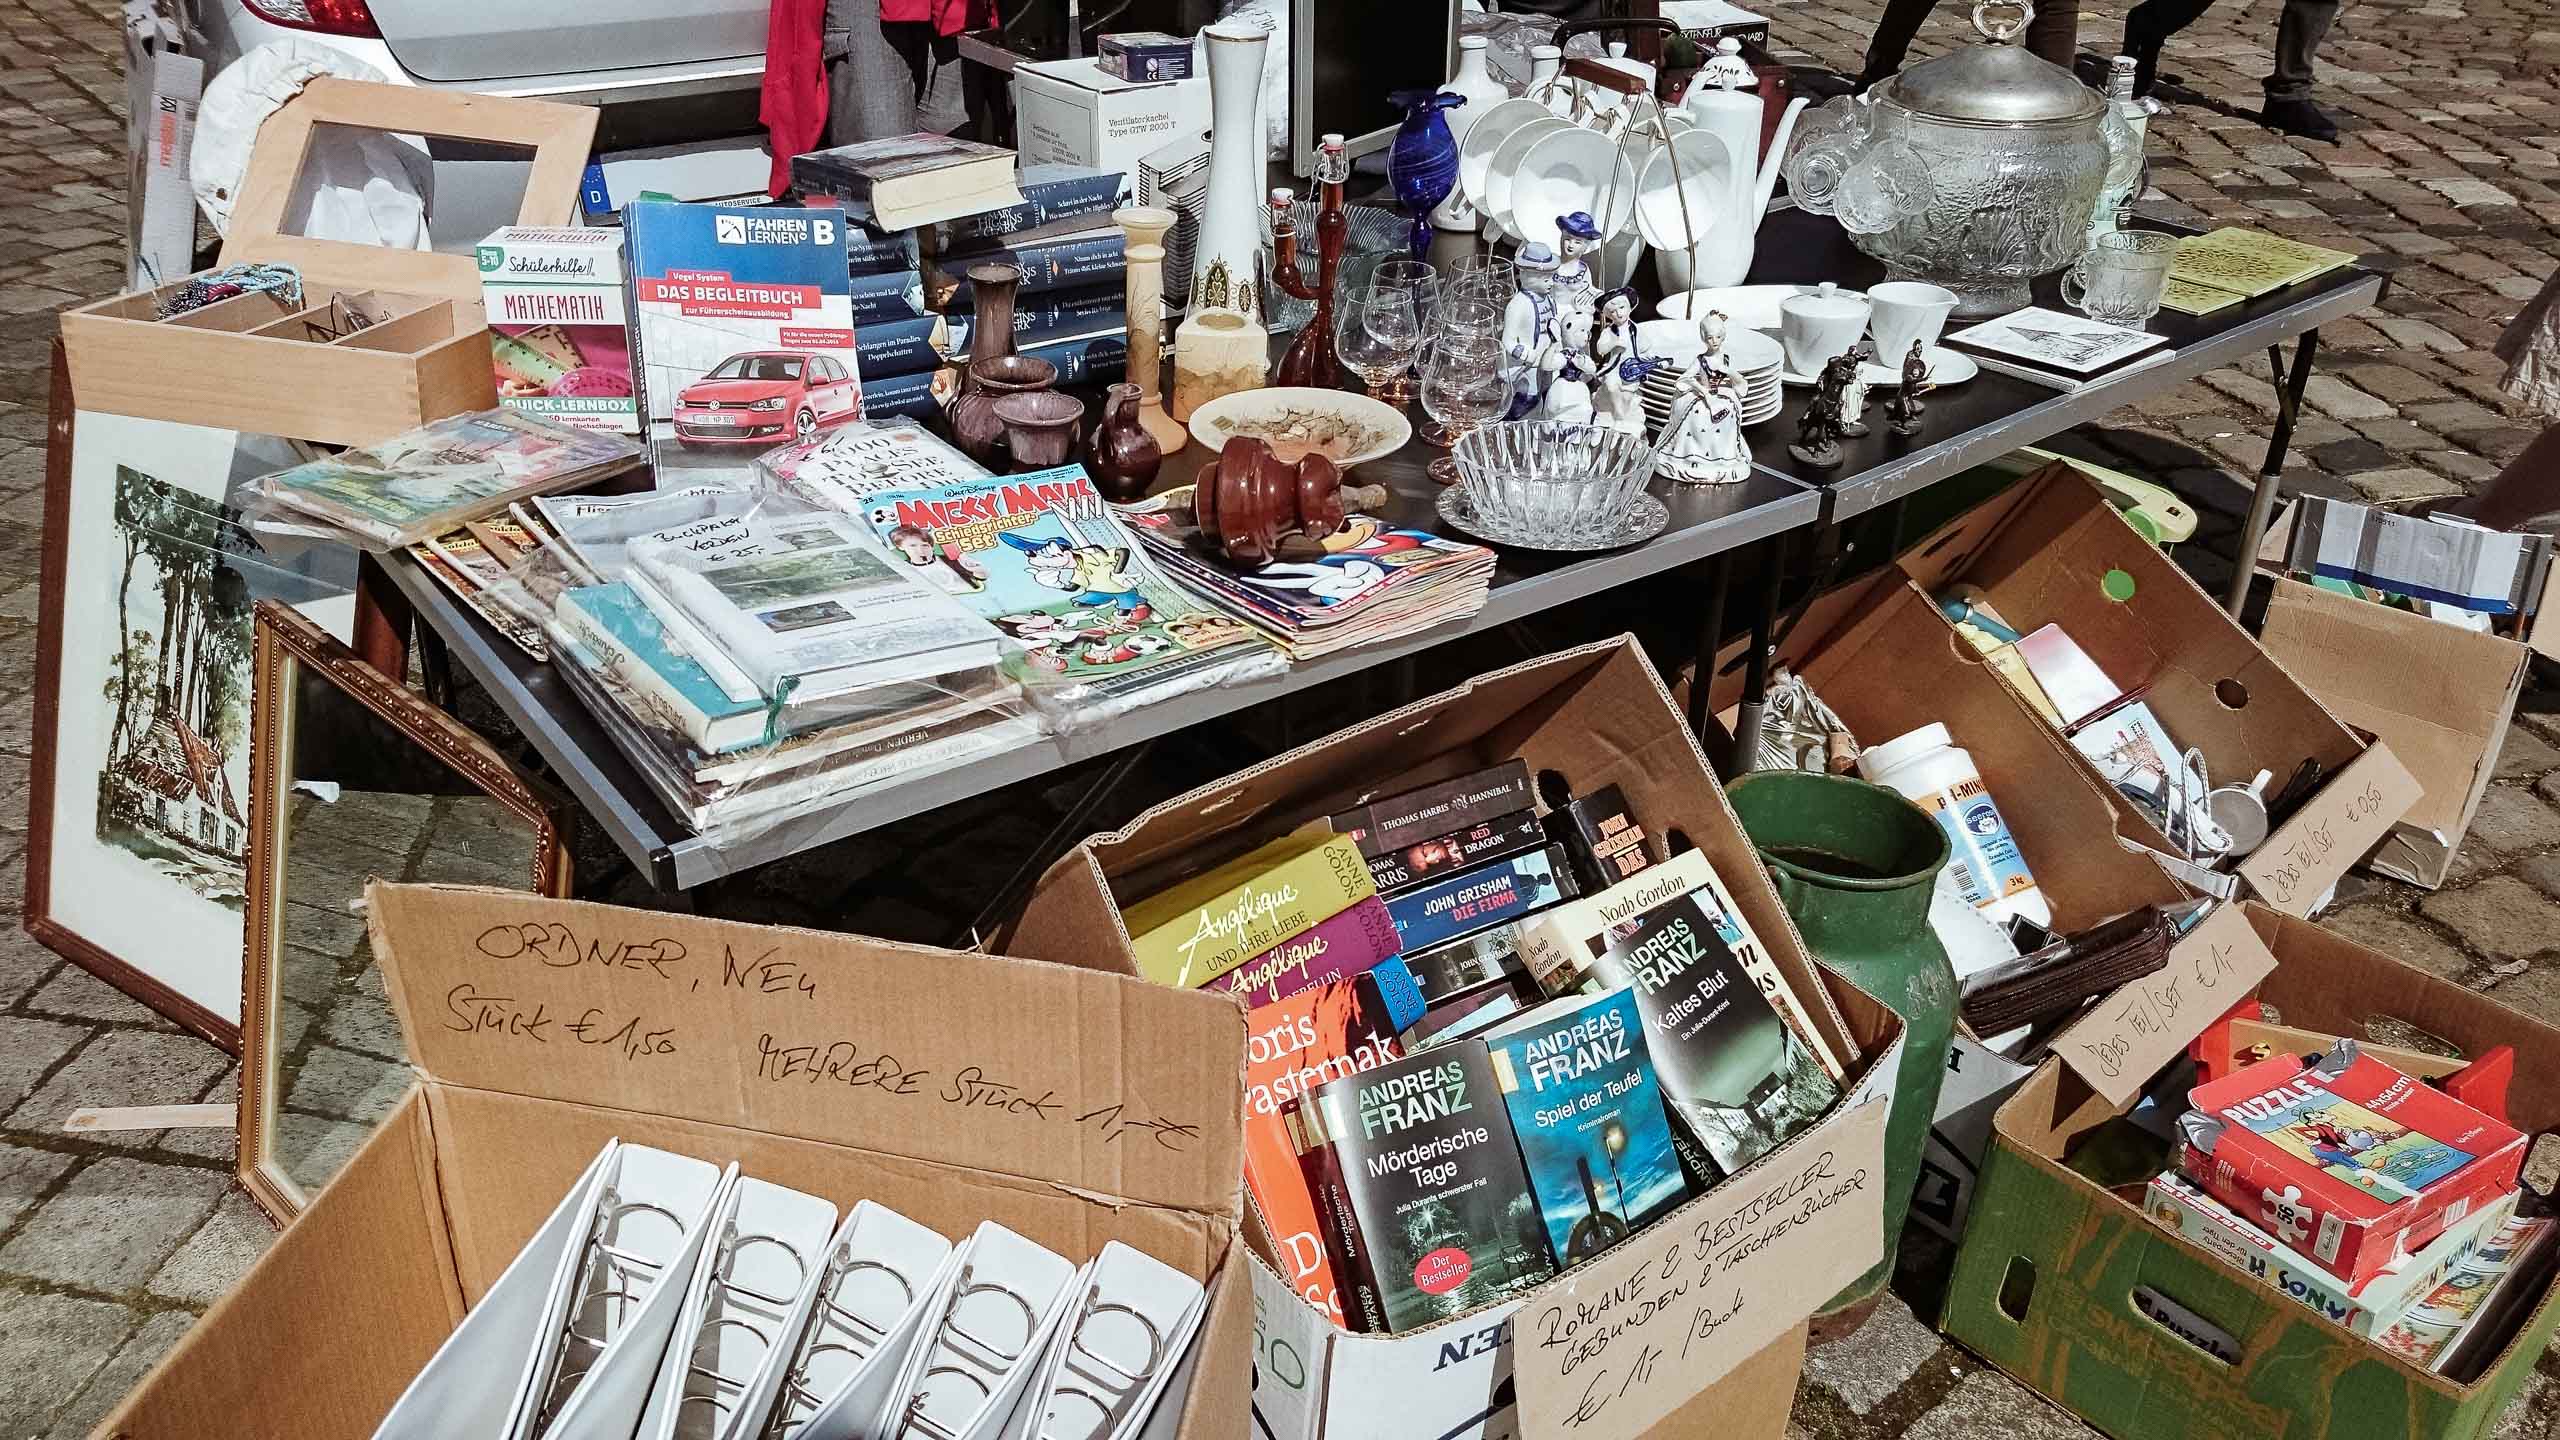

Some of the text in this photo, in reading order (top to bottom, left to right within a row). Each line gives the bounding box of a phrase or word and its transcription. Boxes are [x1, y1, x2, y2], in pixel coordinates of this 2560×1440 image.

[1109, 112, 1169, 127] Ventilatorkachel
[1109, 126, 1128, 137] Type
[1150, 121, 1170, 131] 2000
[1171, 120, 1177, 129] T
[591, 190, 601, 204] D
[747, 218, 807, 233] FAHREN
[749, 231, 799, 245] LERNEN
[812, 219, 836, 246] B
[656, 285, 803, 305] DAS BEGLEITBUCH
[673, 272, 725, 282] Vogel System
[504, 295, 604, 320] MATHEMATIK
[685, 307, 698, 315] zur
[504, 399, 631, 412] QUICK-LERNBOX
[895, 493, 1000, 530] MICKY
[886, 729, 929, 750] VERDEN
[1381, 784, 1512, 831] THOMAS HARRIS HANNIBAL
[1599, 812, 1628, 840] JOHN
[1463, 834, 1505, 855] DRAGON
[1470, 827, 1490, 841] RED
[1593, 825, 1646, 859] GRISHAM
[1323, 846, 1357, 899] GOLON
[1336, 847, 1366, 889] ANNE
[1616, 847, 1647, 876] DAS
[1424, 876, 1512, 916] JOHN GRISHAM
[1599, 874, 1686, 926] Noah Gordon
[2009, 878, 2016, 887] 3
[1367, 904, 1393, 945] ANNE
[1452, 890, 1518, 922] DIE FIRMA
[1177, 884, 1299, 987] Angélique
[1206, 910, 1309, 972] UND IHRE LIEBE
[1353, 904, 1384, 957] GOLON
[1527, 936, 1549, 960] Noah
[1229, 935, 1329, 1002] Angélique
[1460, 958, 1478, 971] JOHN
[1534, 950, 1562, 975] Gordon
[1378, 969, 1409, 1024] GOLON
[1392, 970, 1419, 1010] ANNE
[1652, 992, 1702, 1035] Kaltes
[1697, 968, 1729, 1000] Blut
[1525, 1008, 1623, 1064] ANDREAS
[1680, 1030, 1692, 1042] Ein
[2081, 1033, 2130, 1077] JEDES
[2195, 960, 2216, 988] €
[602, 1016, 676, 1061] 1,50
[758, 1033, 929, 1094] MEHRERE
[1528, 1027, 1631, 1092] FRANZ
[1359, 1061, 1464, 1111] ANDREAS
[1534, 1068, 1643, 1128] Spiel der Teufel
[2221, 1080, 2327, 1126] PUZZLE
[1360, 1081, 1473, 1141] FRANZ
[1577, 1108, 1621, 1133] Kriminalroman
[1367, 1125, 1489, 1179] Mörderische
[1408, 1159, 1459, 1189] Tage
[1395, 1177, 1488, 1216] Julia Durants schwerster Fall
[1331, 1184, 1356, 1258] Mörderische
[1537, 1152, 1835, 1348] ROMANE & BESTSELLER
[2220, 1234, 2235, 1250] den
[1421, 1261, 1470, 1287] Bestseller
[1431, 1254, 1451, 1270] Der
[1561, 1279, 1688, 1375] GEBUNDEN
[1700, 1263, 1712, 1288] &
[1562, 1369, 1612, 1428] €
